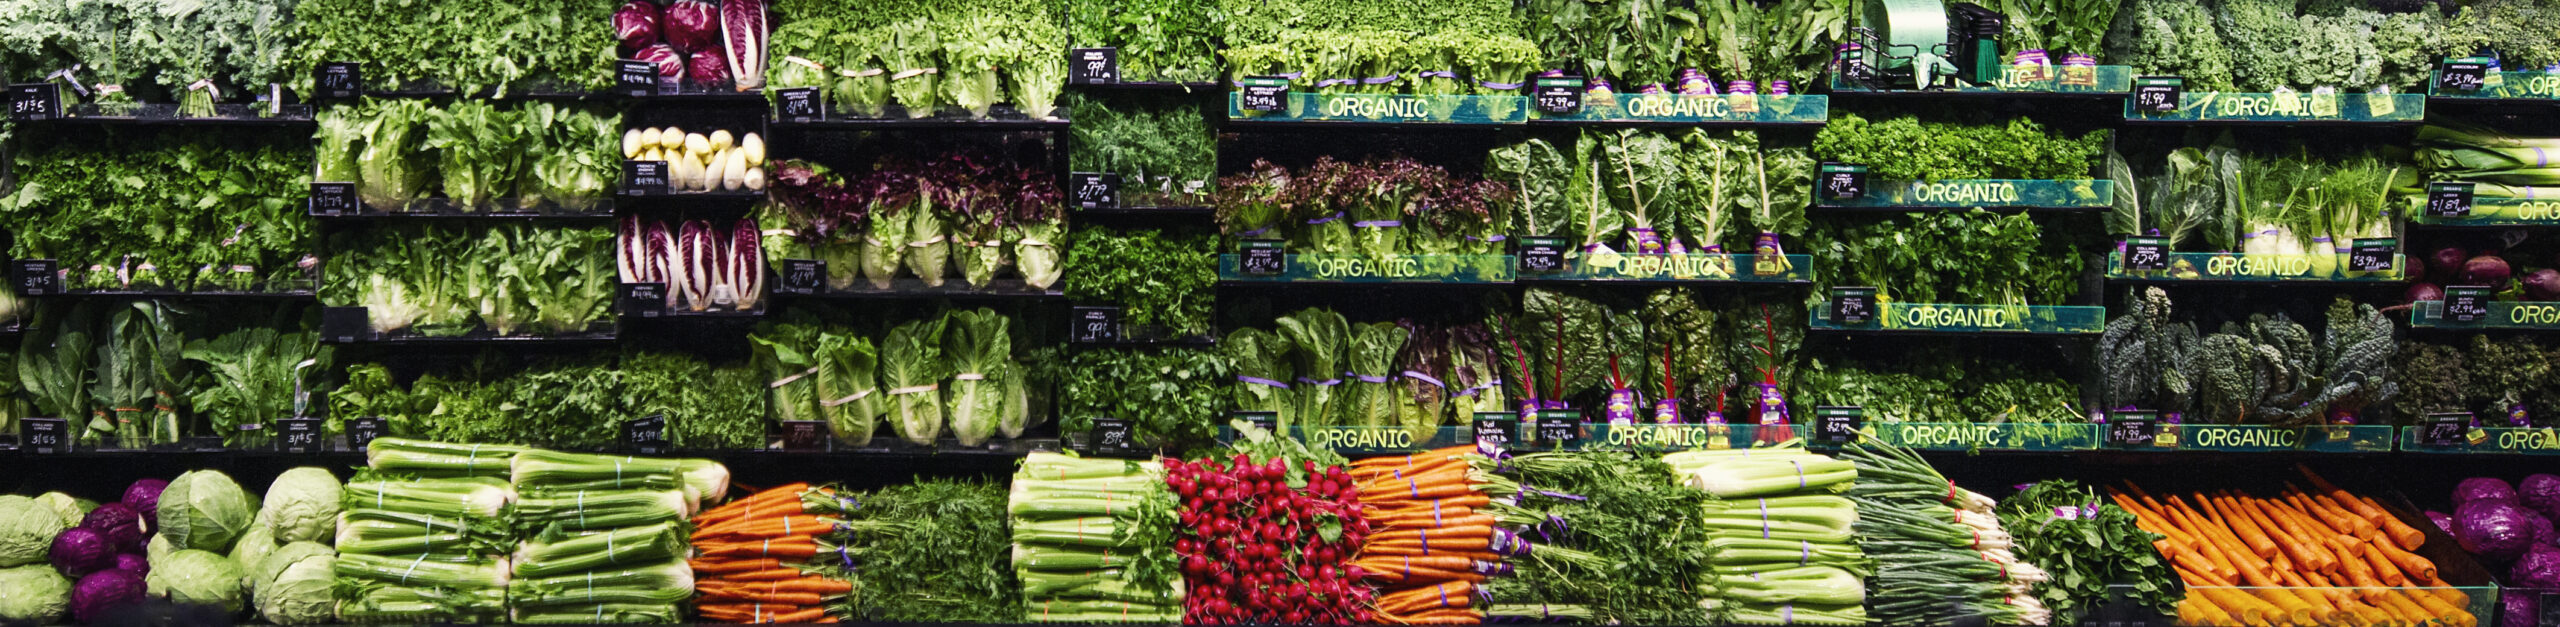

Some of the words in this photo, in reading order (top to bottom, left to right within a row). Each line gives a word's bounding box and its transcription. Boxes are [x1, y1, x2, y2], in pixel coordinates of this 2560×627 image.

[1328, 97, 1428, 118] ORGANIC
[1628, 97, 1728, 117] ORGANIC
[2224, 97, 2322, 116] ORGANIC
[1915, 183, 2014, 202] ORGANIC
[1318, 258, 1416, 277] ORGANIC
[1616, 256, 1714, 276] ORGANIC
[2207, 257, 2307, 277] ORGANIC
[1908, 308, 2006, 328] ORGANIC
[1314, 429, 1411, 448] ORGANIC
[1608, 427, 1706, 446] ORGANIC
[1902, 425, 2000, 445] ORGANIC
[2197, 429, 2294, 447] ORGANIC
